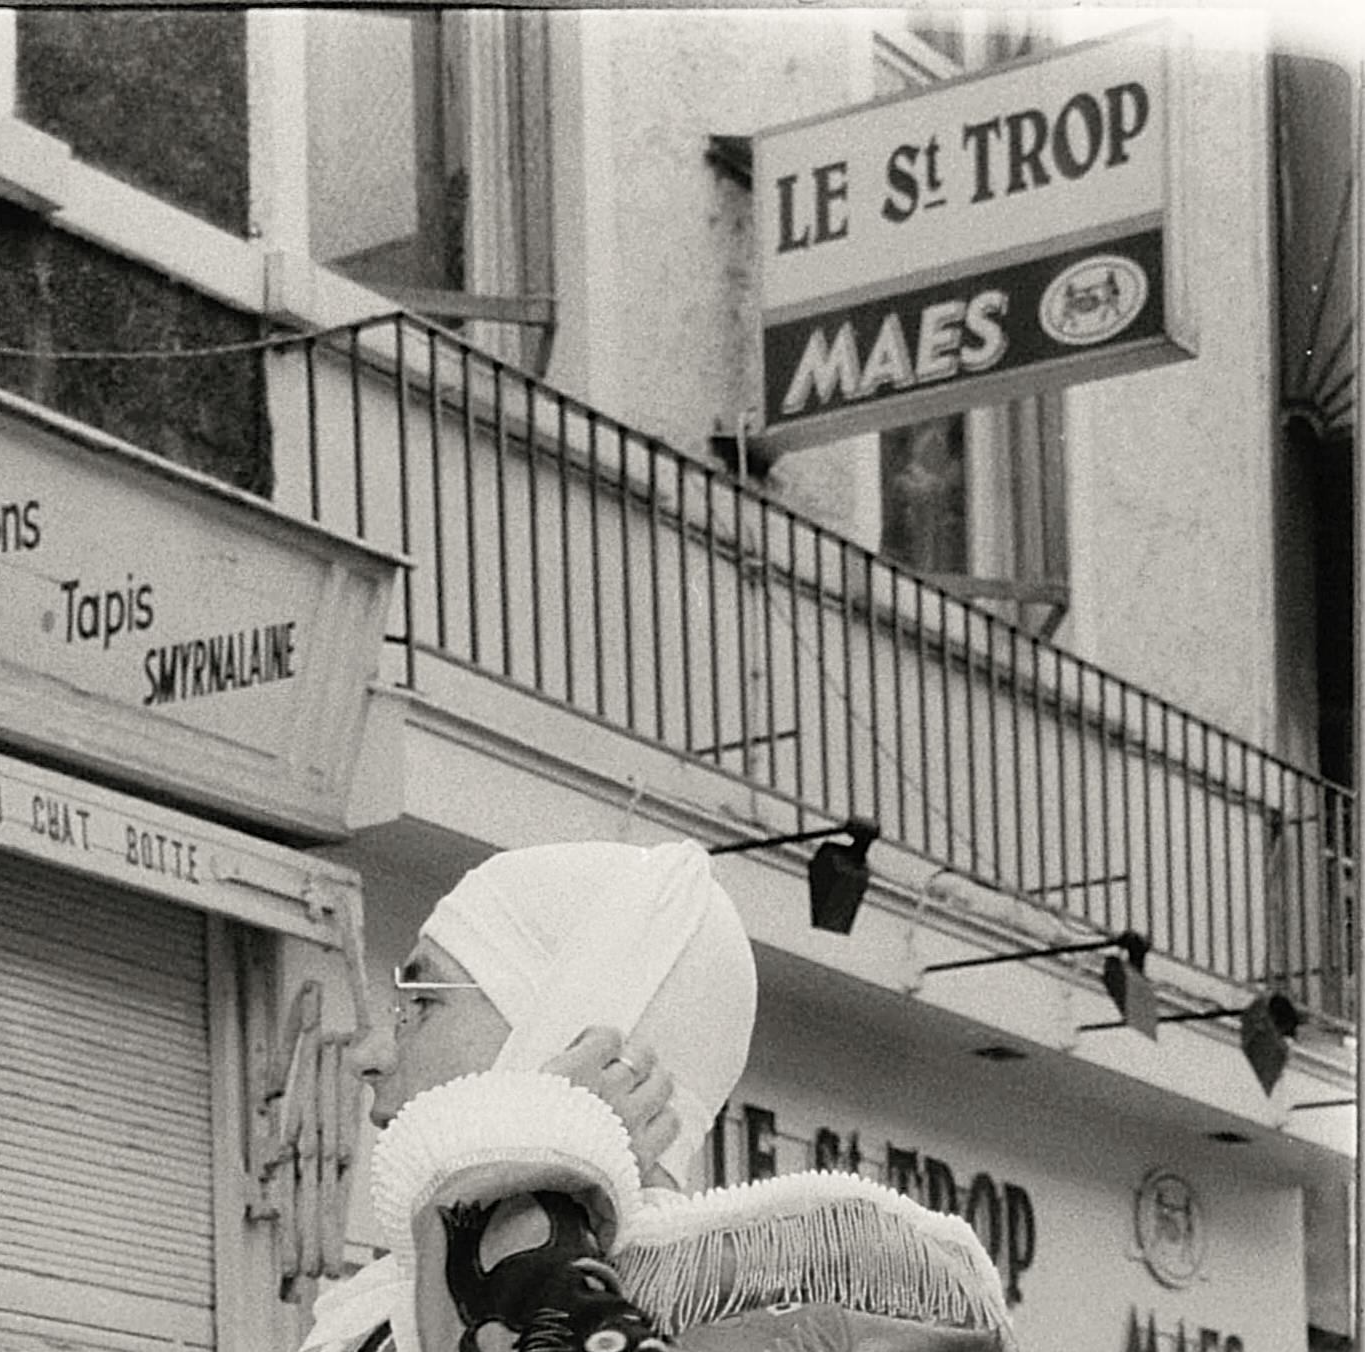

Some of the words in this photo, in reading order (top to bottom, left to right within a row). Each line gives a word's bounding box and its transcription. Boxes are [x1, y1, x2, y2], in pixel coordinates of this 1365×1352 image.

[776, 161, 848, 254] LE
[880, 135, 947, 223] St
[962, 81, 1150, 204] TROP
[781, 290, 1009, 414] MAES
[60, 573, 154, 649] Tapis
[143, 621, 296, 706] SMYRNALAINE
[31, 795, 90, 851] CHAT
[126, 824, 200, 884] BOTTE
